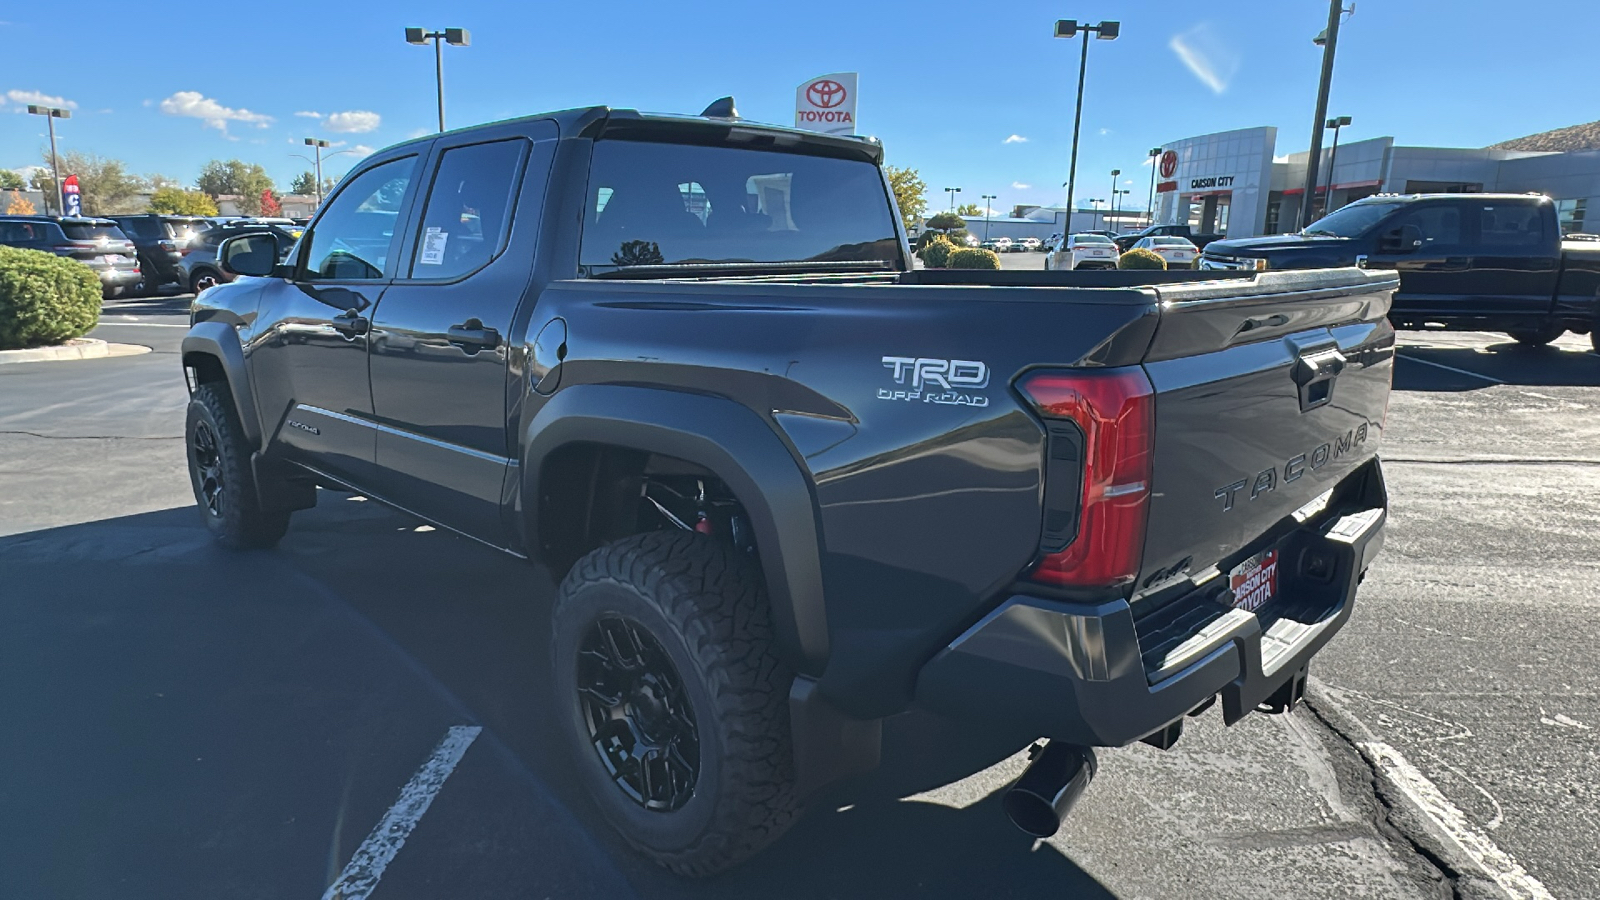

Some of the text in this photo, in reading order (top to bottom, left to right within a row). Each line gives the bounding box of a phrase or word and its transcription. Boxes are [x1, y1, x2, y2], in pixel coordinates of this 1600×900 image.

[798, 111, 852, 122] TOYOTA
[1191, 176, 1234, 188] CARSON CITY
[881, 356, 990, 392] TRD
[876, 387, 990, 407] OFF ROAD
[1214, 422, 1368, 512] TACOMA
[1261, 561, 1277, 583] CITY
